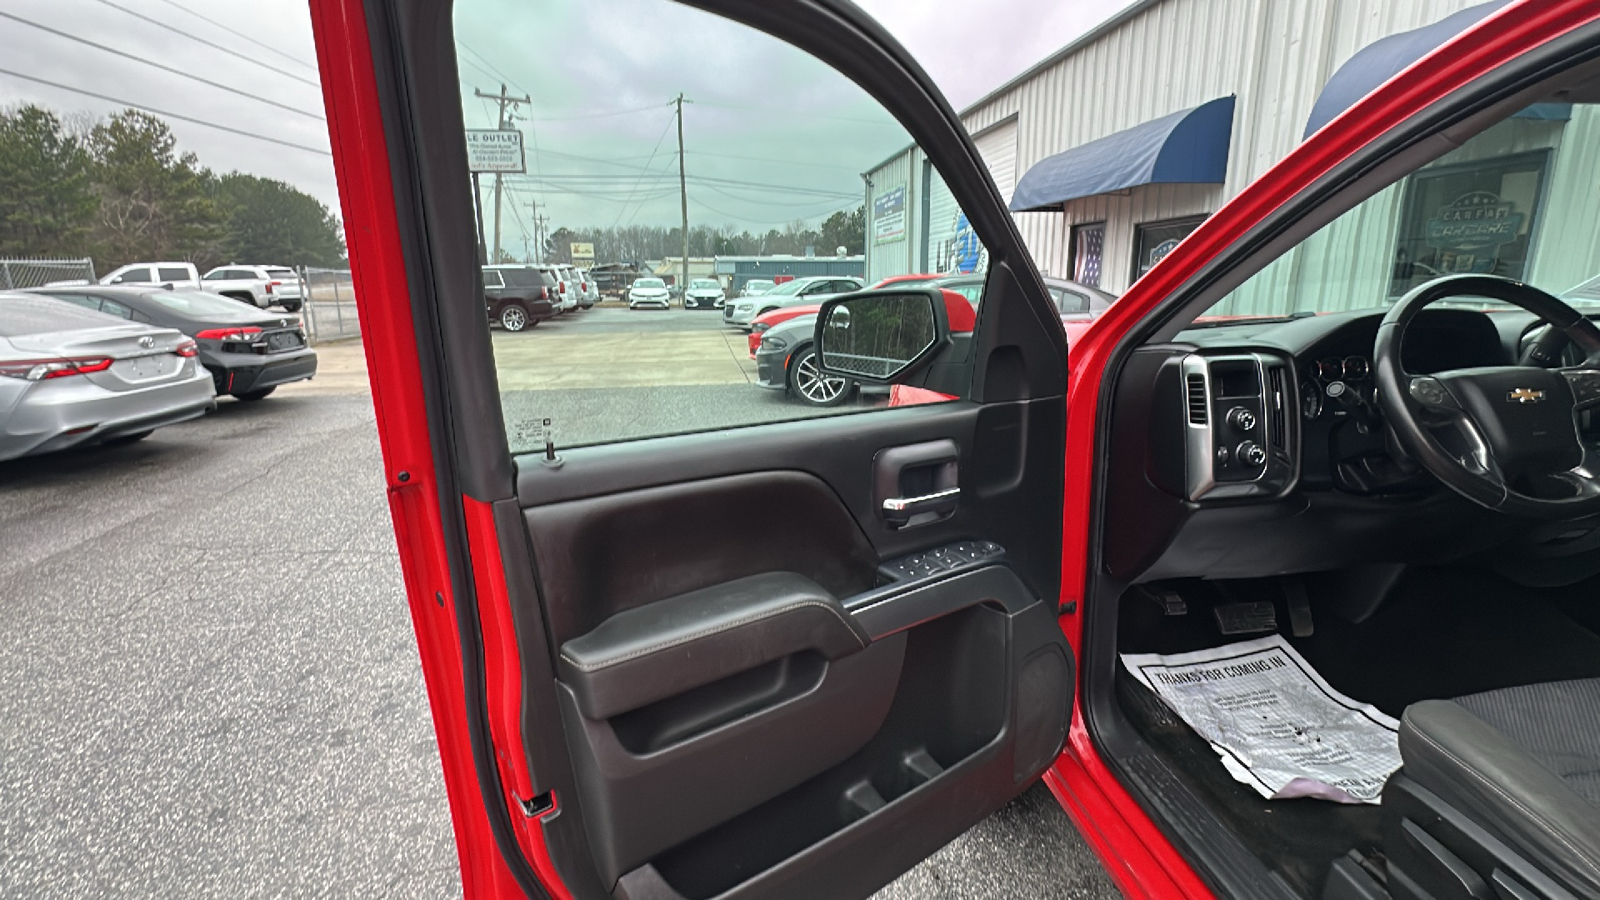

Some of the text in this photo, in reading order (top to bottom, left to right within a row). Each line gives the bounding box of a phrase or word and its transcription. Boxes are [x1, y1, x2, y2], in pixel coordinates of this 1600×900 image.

[482, 134, 518, 142] OUTLET
[1156, 656, 1286, 686] THANKS FOR COMING IN
